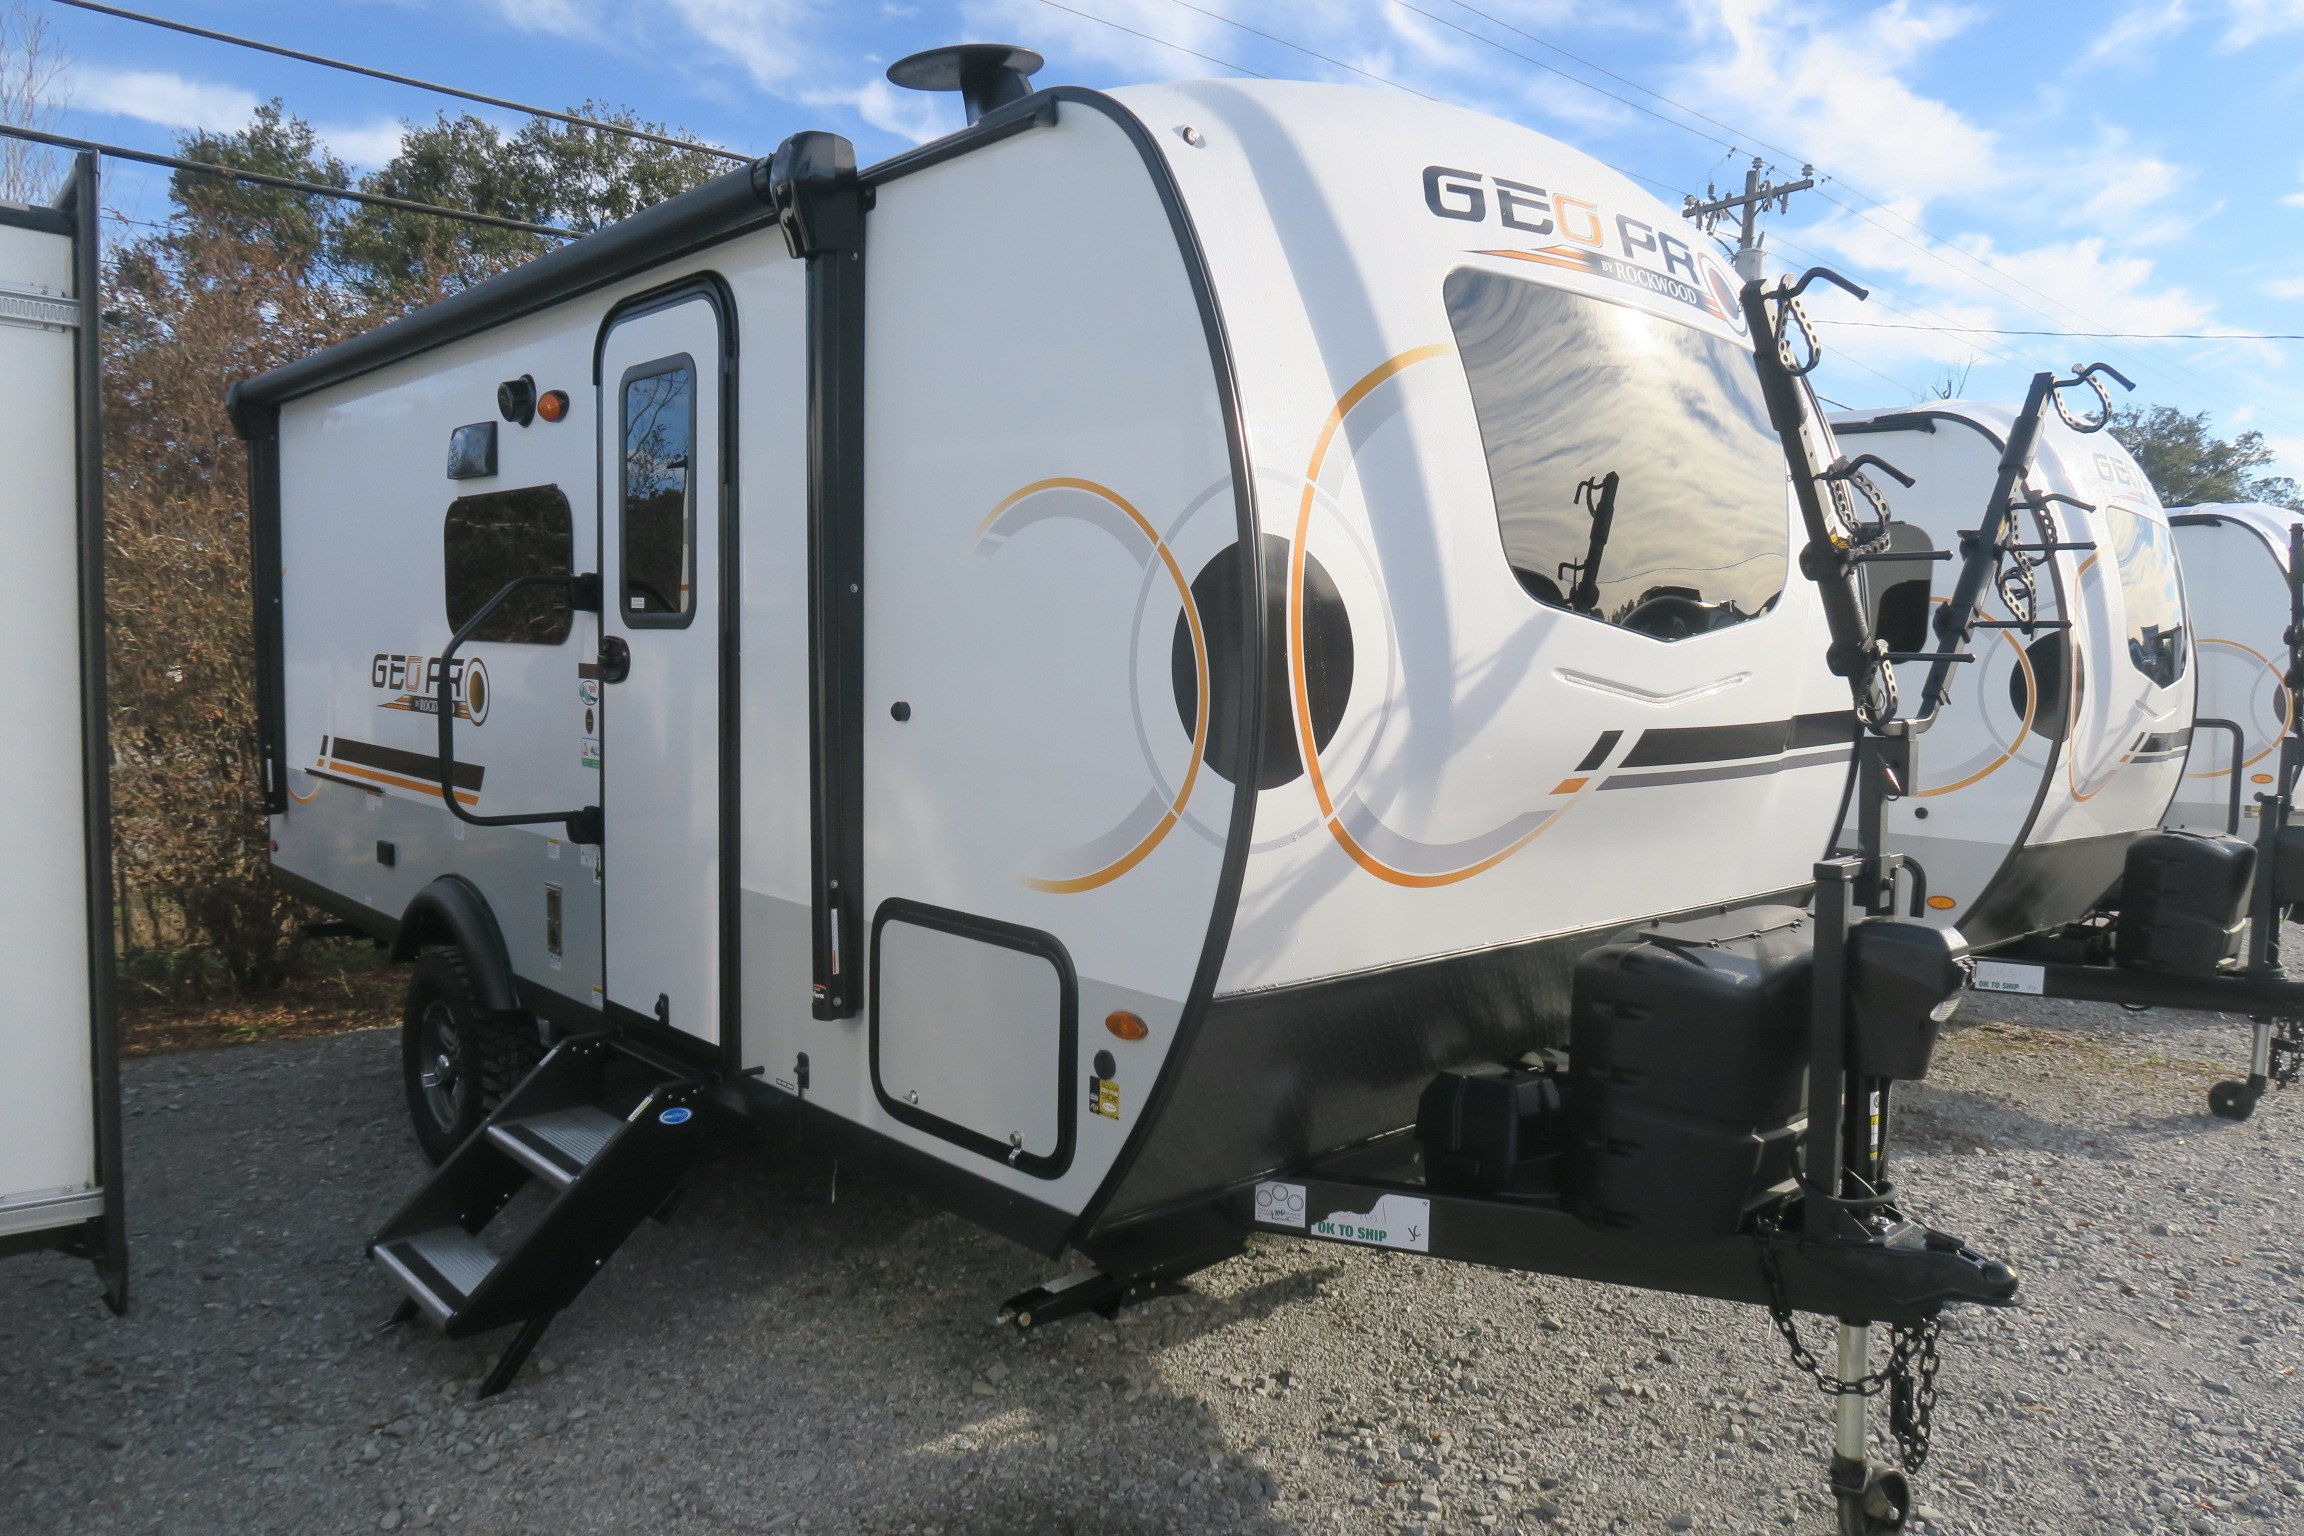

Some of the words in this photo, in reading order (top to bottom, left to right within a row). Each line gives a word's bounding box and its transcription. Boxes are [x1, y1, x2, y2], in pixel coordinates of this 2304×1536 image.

[1422, 165, 1604, 248] GEO
[1600, 259, 1614, 275] BY
[1615, 260, 1697, 306] ROCKWOOD
[371, 653, 423, 693] GEO
[1317, 1221, 1335, 1235] OK
[1339, 1223, 1354, 1238] TO
[1357, 1227, 1388, 1242] SHIP
